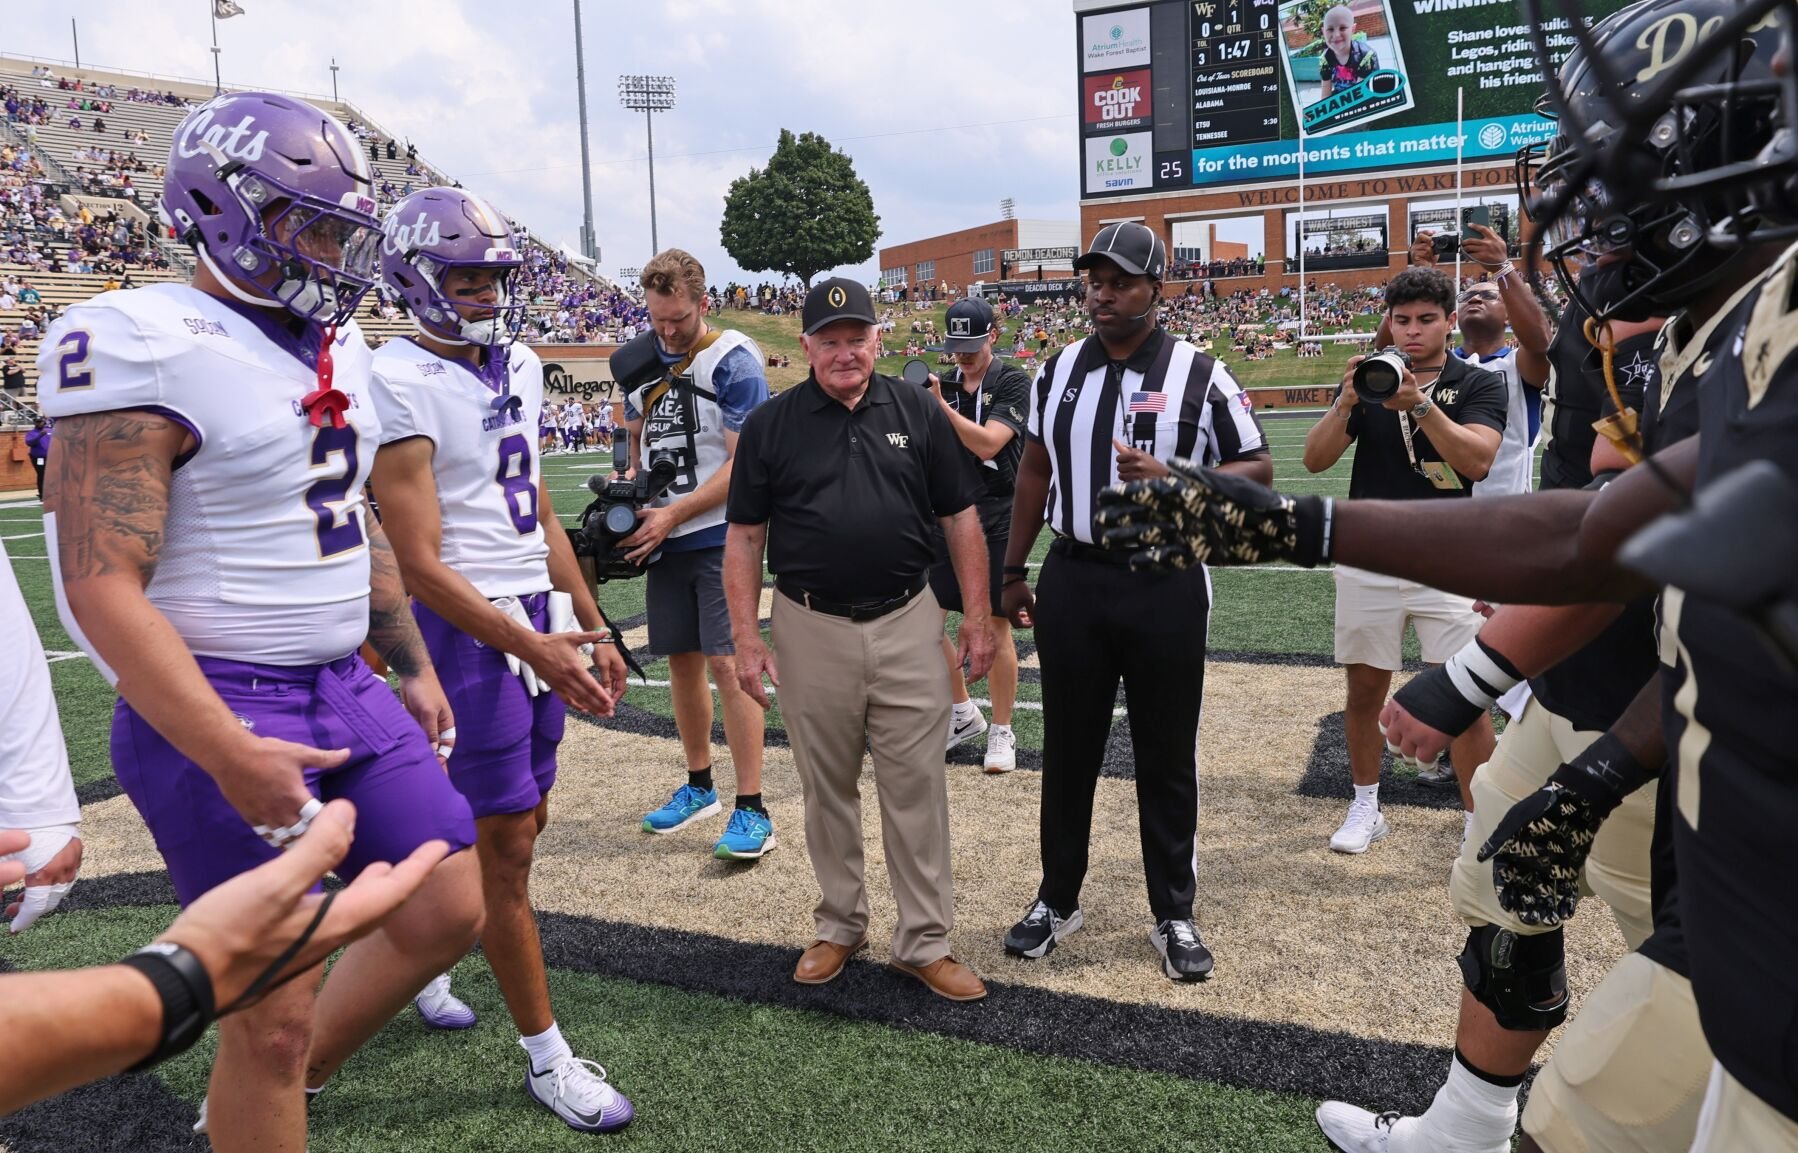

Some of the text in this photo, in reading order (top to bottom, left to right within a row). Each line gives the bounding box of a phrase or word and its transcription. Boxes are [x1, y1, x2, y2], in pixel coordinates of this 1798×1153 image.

[1231, 10, 1237, 23] 1
[1260, 13, 1269, 30] 0
[1201, 22, 1210, 38] 0
[1226, 24, 1241, 34] QTR
[1447, 16, 1594, 44] Shane loves uildg
[1092, 43, 1118, 51] Atrium
[1218, 39, 1251, 60] 1:47
[1264, 43, 1272, 57] 3
[1451, 44, 1499, 60] Legos,
[1501, 37, 1537, 53] ridin
[1198, 52, 1206, 65] 3
[1231, 66, 1274, 79] SCOREBOARD
[1447, 61, 1475, 77] and
[1476, 57, 1533, 73] hanging
[1195, 82, 1278, 97] LOUISIANA-MONROE 7:45
[1480, 75, 1501, 89] his
[1094, 86, 1141, 107] COOK
[1195, 98, 1225, 110] ALABAMA
[1102, 102, 1135, 120] OUT
[1302, 87, 1365, 123] SHANE
[1334, 95, 1401, 121] WINNING MOMENT
[1096, 118, 1141, 129] FRESH BURGERS
[1195, 117, 1278, 129] ETSU 3:30
[1510, 121, 1558, 135] Atrium
[178, 108, 270, 162] Cats
[1195, 130, 1228, 141] TENNESSEE
[1510, 135, 1542, 147] Wake
[1198, 133, 1468, 173] for the moments that matter
[1096, 155, 1142, 173] KELLY
[1160, 161, 1183, 179] 25
[1105, 177, 1134, 188] savin
[1238, 183, 1349, 207] WELCOME
[1358, 178, 1388, 196] TO
[113, 203, 124, 212] 12
[1308, 215, 1374, 232] WAKE FOREST
[383, 212, 440, 256] Cats
[1004, 247, 1075, 261] DEMON DEACONS
[1025, 284, 1048, 293] DEACON
[1048, 282, 1064, 292] DECK
[55, 327, 96, 393] 2
[548, 373, 617, 401] Allegacy
[1285, 388, 1320, 404] WAKE
[885, 433, 909, 448] WF
[304, 419, 366, 560] 2
[495, 432, 540, 538] 8
